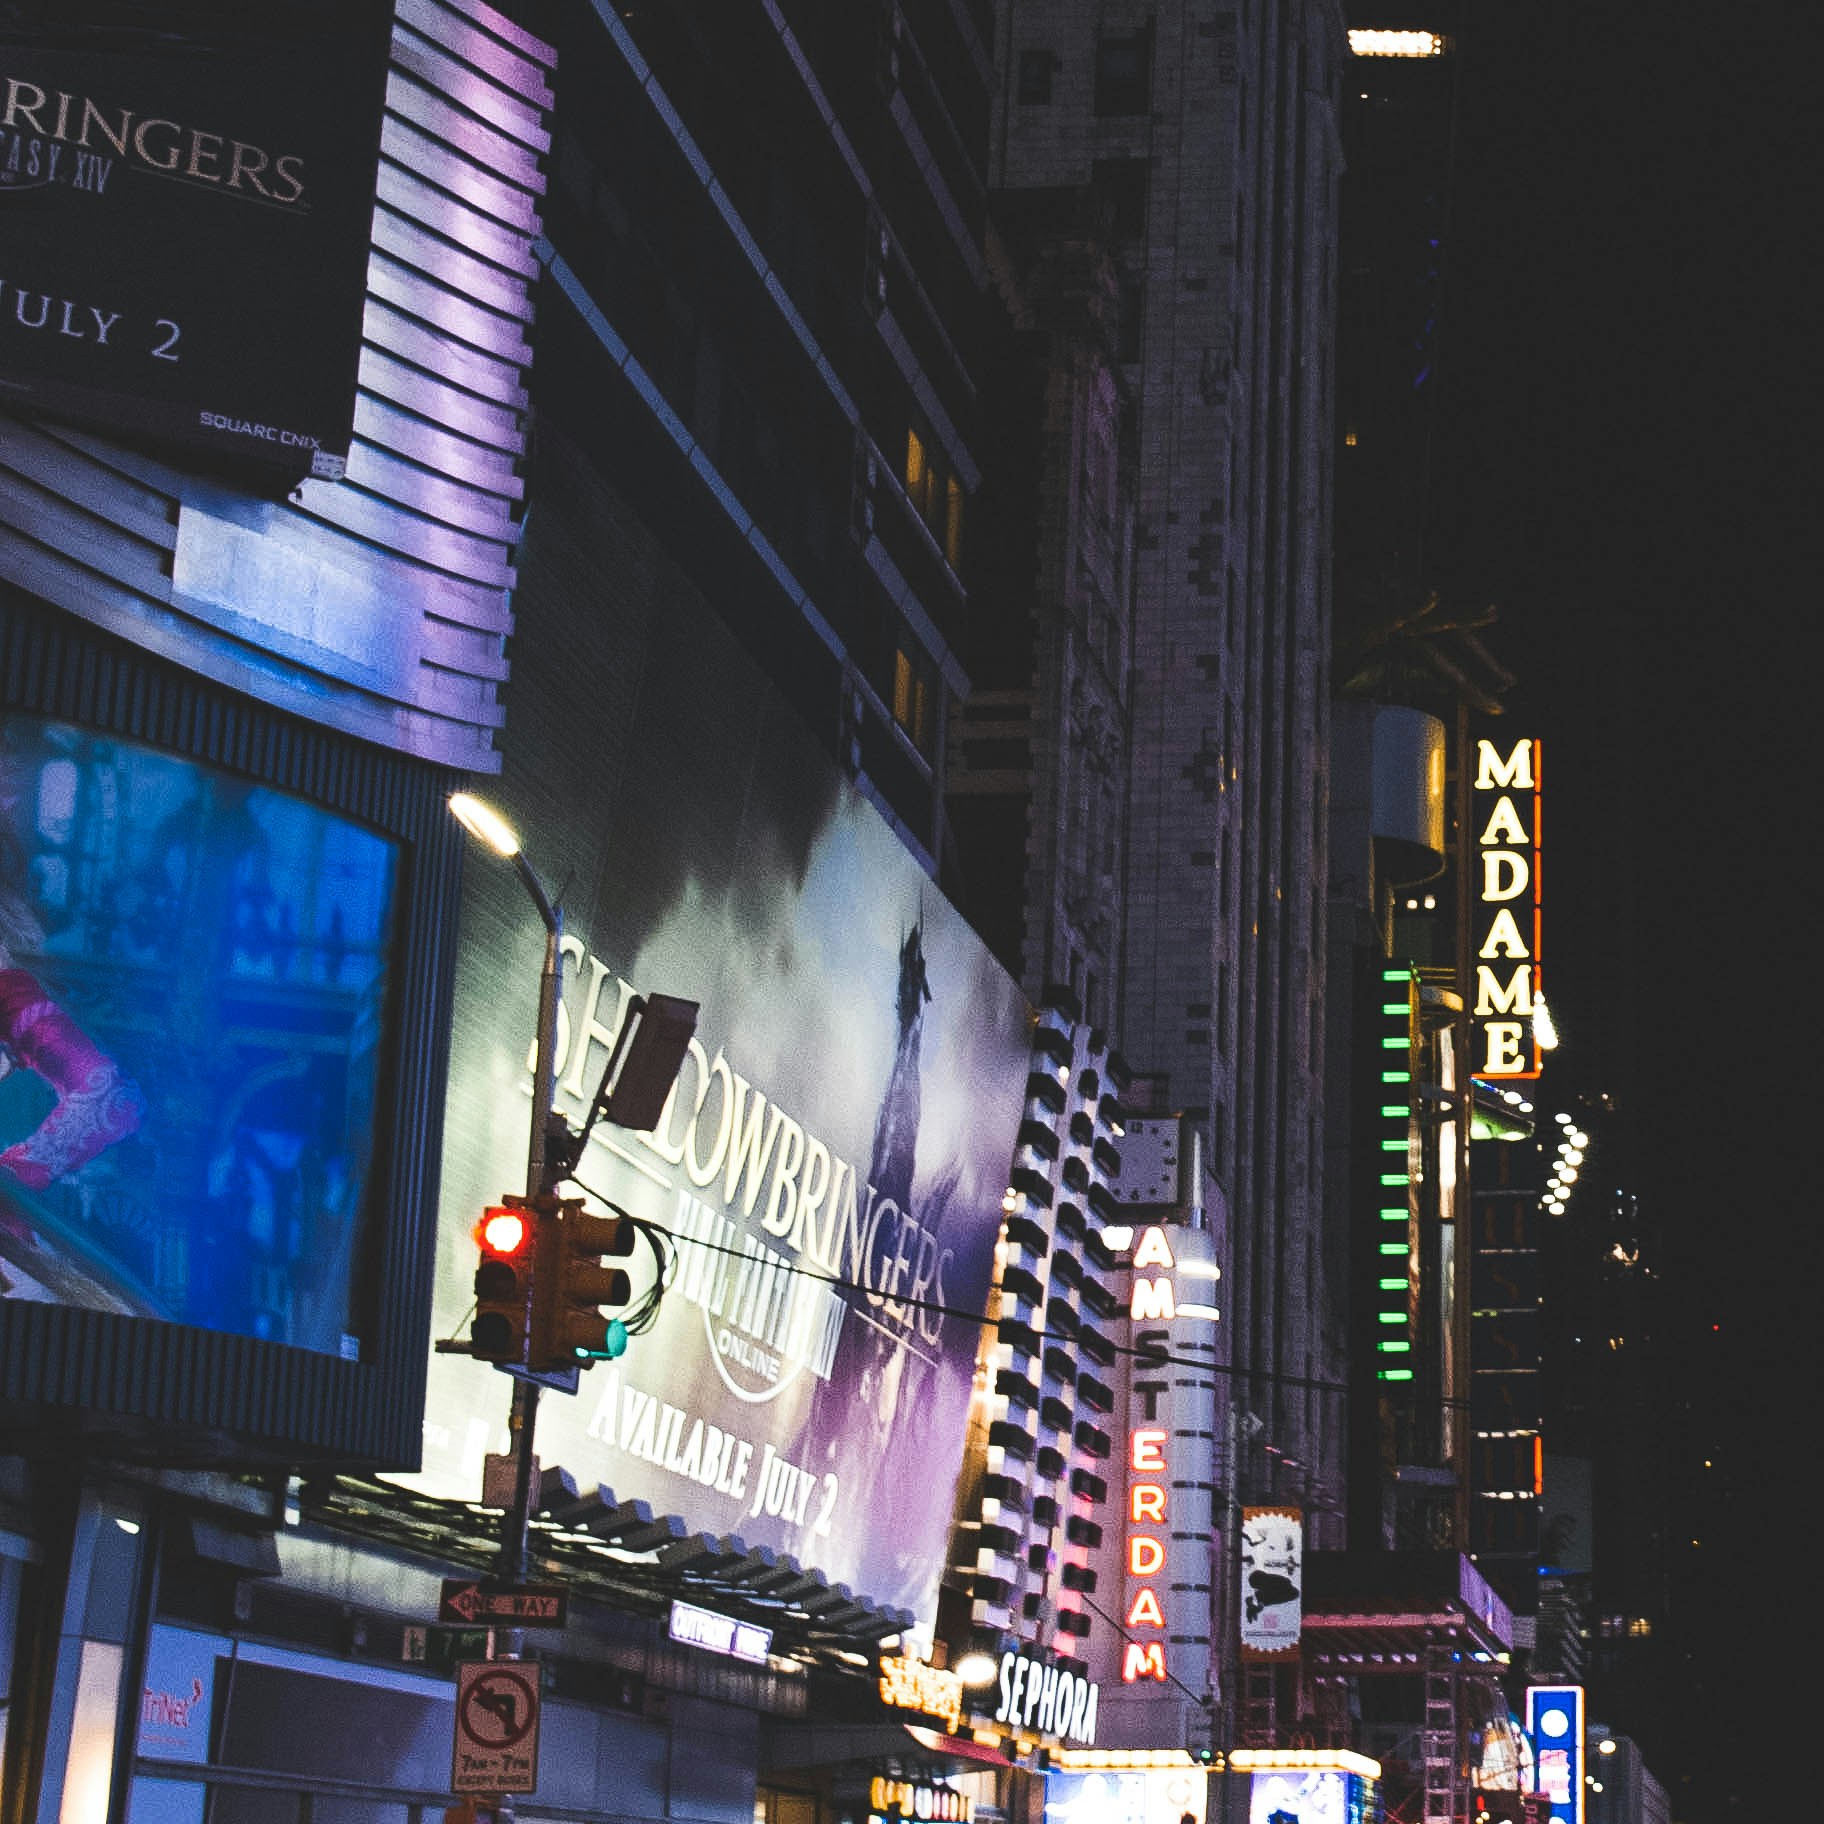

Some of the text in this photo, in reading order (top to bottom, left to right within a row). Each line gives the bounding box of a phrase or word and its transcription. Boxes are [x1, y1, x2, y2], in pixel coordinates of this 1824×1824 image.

[0, 278, 183, 363] ULY 2
[1474, 737, 1535, 1075] MADAME
[526, 934, 955, 1349] SHDOWBRINGERS
[718, 1328, 780, 1384] ONLINE
[587, 1367, 839, 1537] AVAILABLE JULY 2
[1121, 1225, 1176, 1684] AMSTERDAM
[460, 1593, 552, 1615] ONE WAY
[996, 1651, 1099, 1746] SEPHORA
